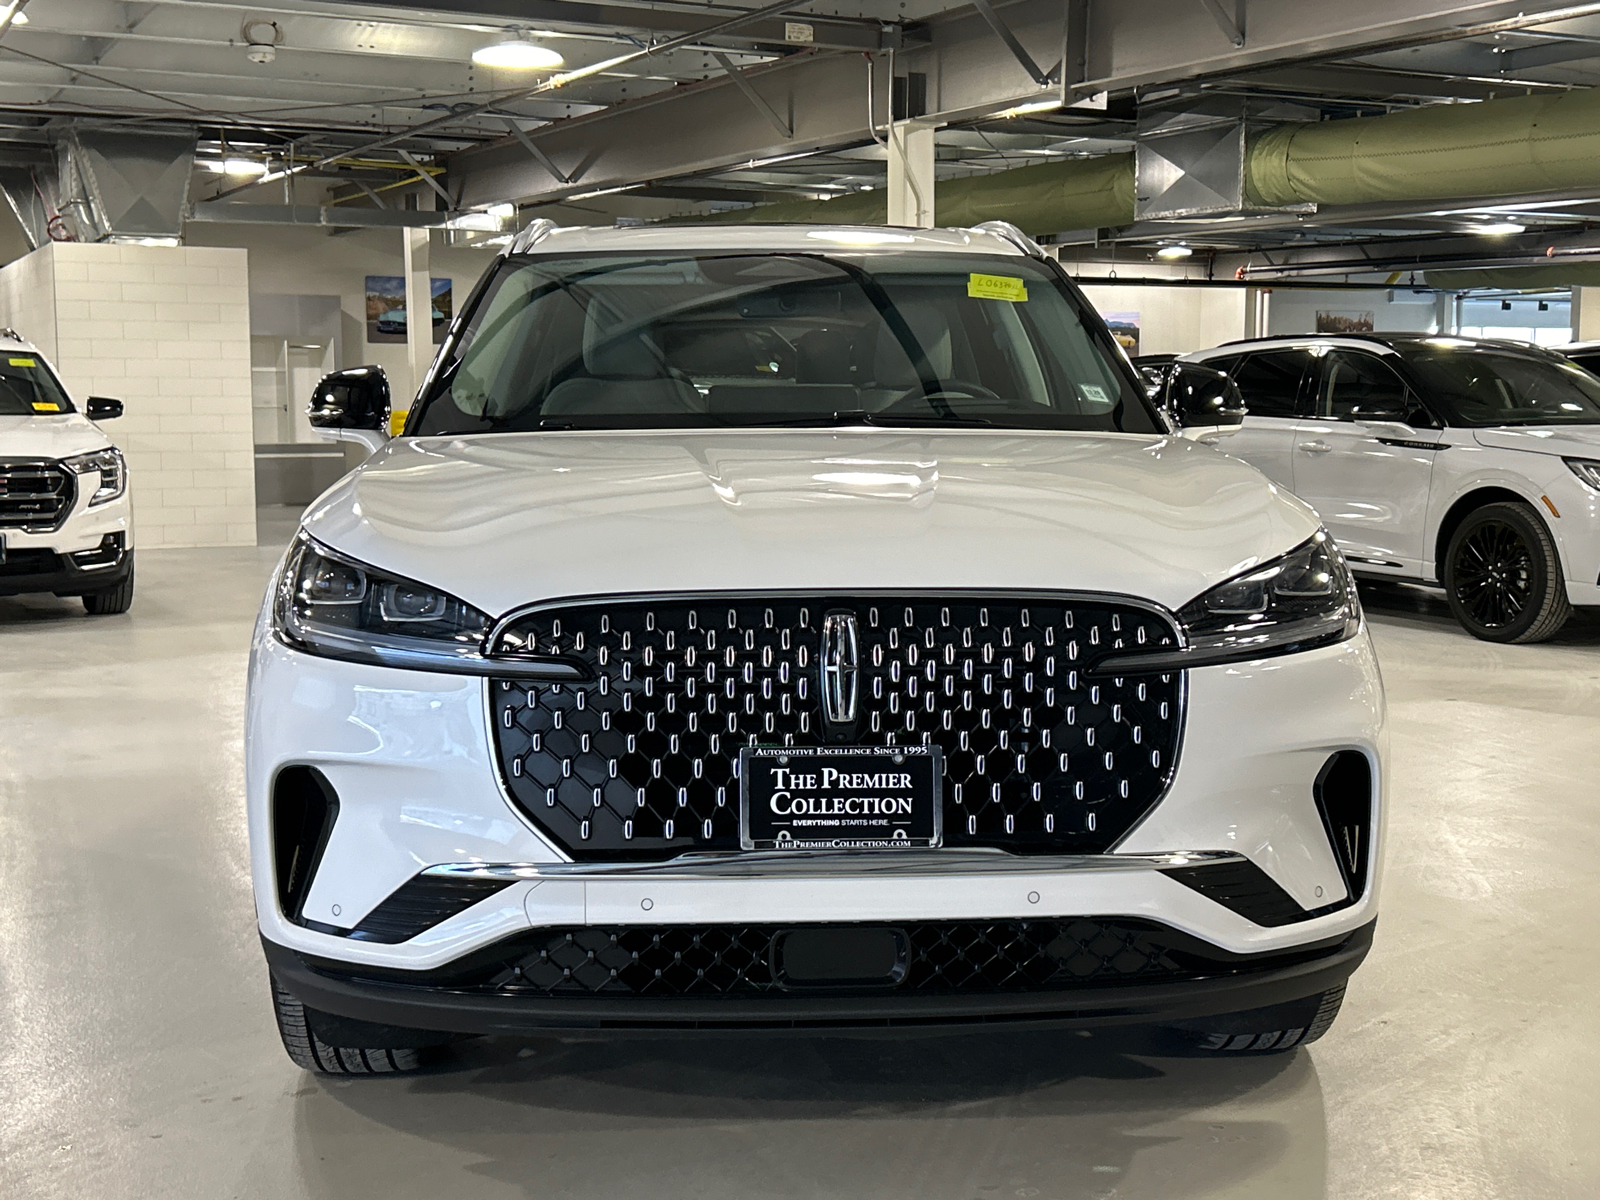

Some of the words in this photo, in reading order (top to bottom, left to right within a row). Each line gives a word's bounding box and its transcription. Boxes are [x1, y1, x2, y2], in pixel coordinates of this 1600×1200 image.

[755, 747, 814, 756] AUTOMOTIVE
[816, 747, 872, 755] EXCELLENCE
[873, 746, 901, 755] SINCE
[903, 746, 928, 755] 1995
[769, 767, 817, 790] THE
[820, 767, 913, 789] PREMIER
[769, 791, 913, 815] COLLECTION
[792, 819, 840, 827] EVERYTHING
